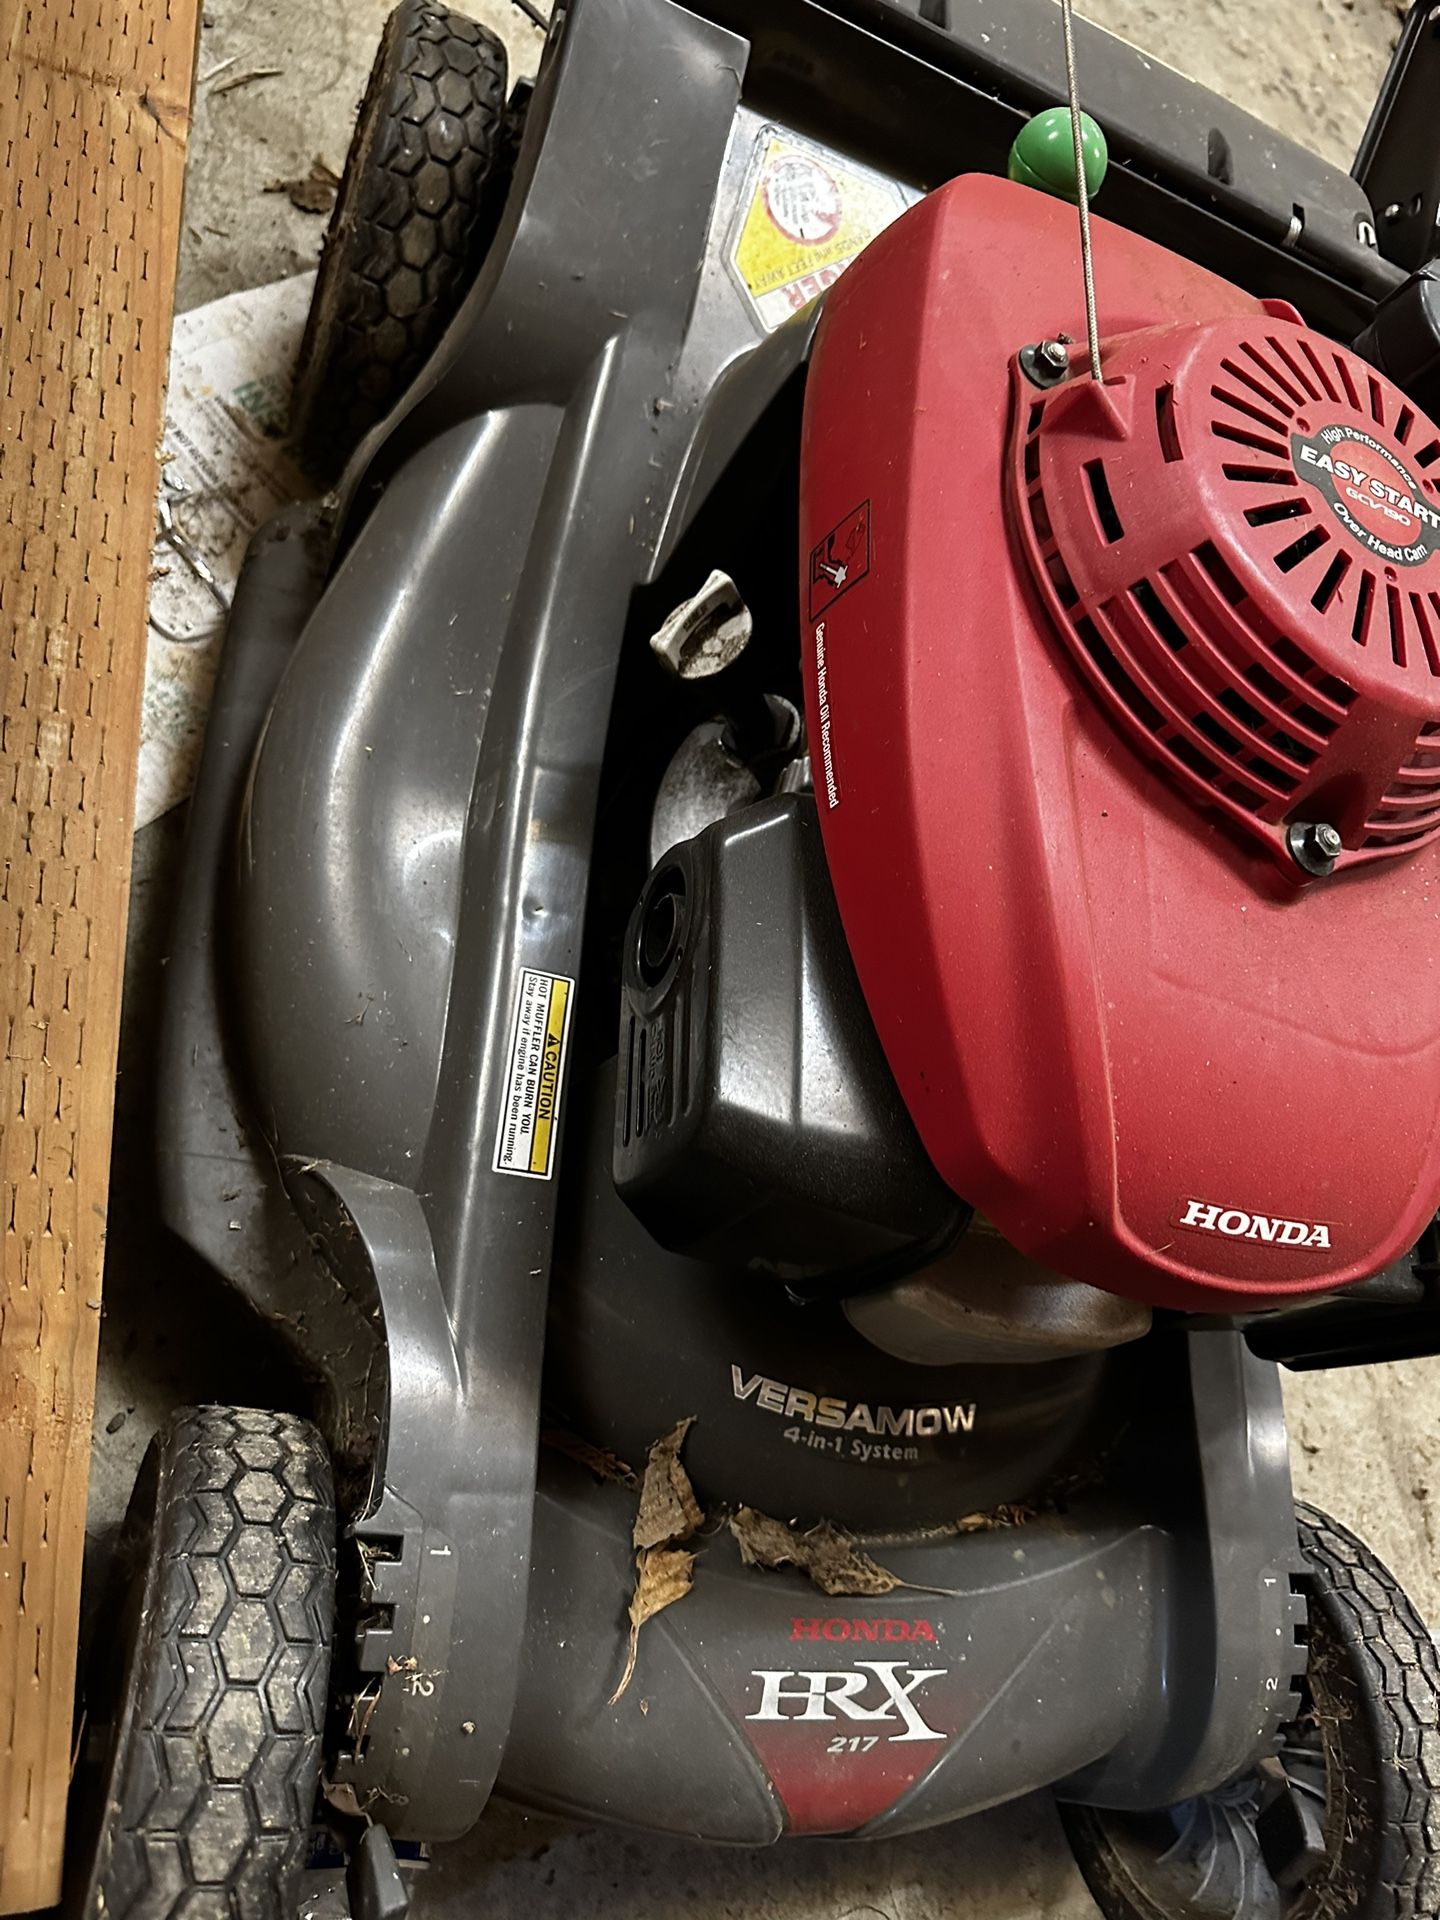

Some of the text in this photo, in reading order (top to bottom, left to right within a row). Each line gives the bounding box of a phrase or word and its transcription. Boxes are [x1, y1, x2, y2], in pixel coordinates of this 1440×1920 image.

[755, 267, 785, 290] AWAY
[782, 261, 846, 308] GER
[788, 255, 814, 276] FEET
[1300, 444, 1440, 529] EASY START
[1320, 426, 1417, 490] High Performance
[1333, 502, 1428, 562] Over Head Cam
[815, 622, 839, 809] Genuine Honda Oil Recommended
[502, 976, 538, 1165] Stay away if engine has been running.
[520, 979, 549, 1136] HOT MUFFLER CAN BURN YOU.
[538, 1051, 557, 1120] CAUTION
[1180, 1200, 1332, 1248] HONDA
[731, 1363, 977, 1437] VERSAMOW
[783, 1426, 919, 1462] 4-in-1 System
[788, 1617, 938, 1642] HONDA
[745, 1661, 948, 1742] HRX
[1266, 1677, 1279, 1691] 2
[827, 1736, 879, 1753] 217
